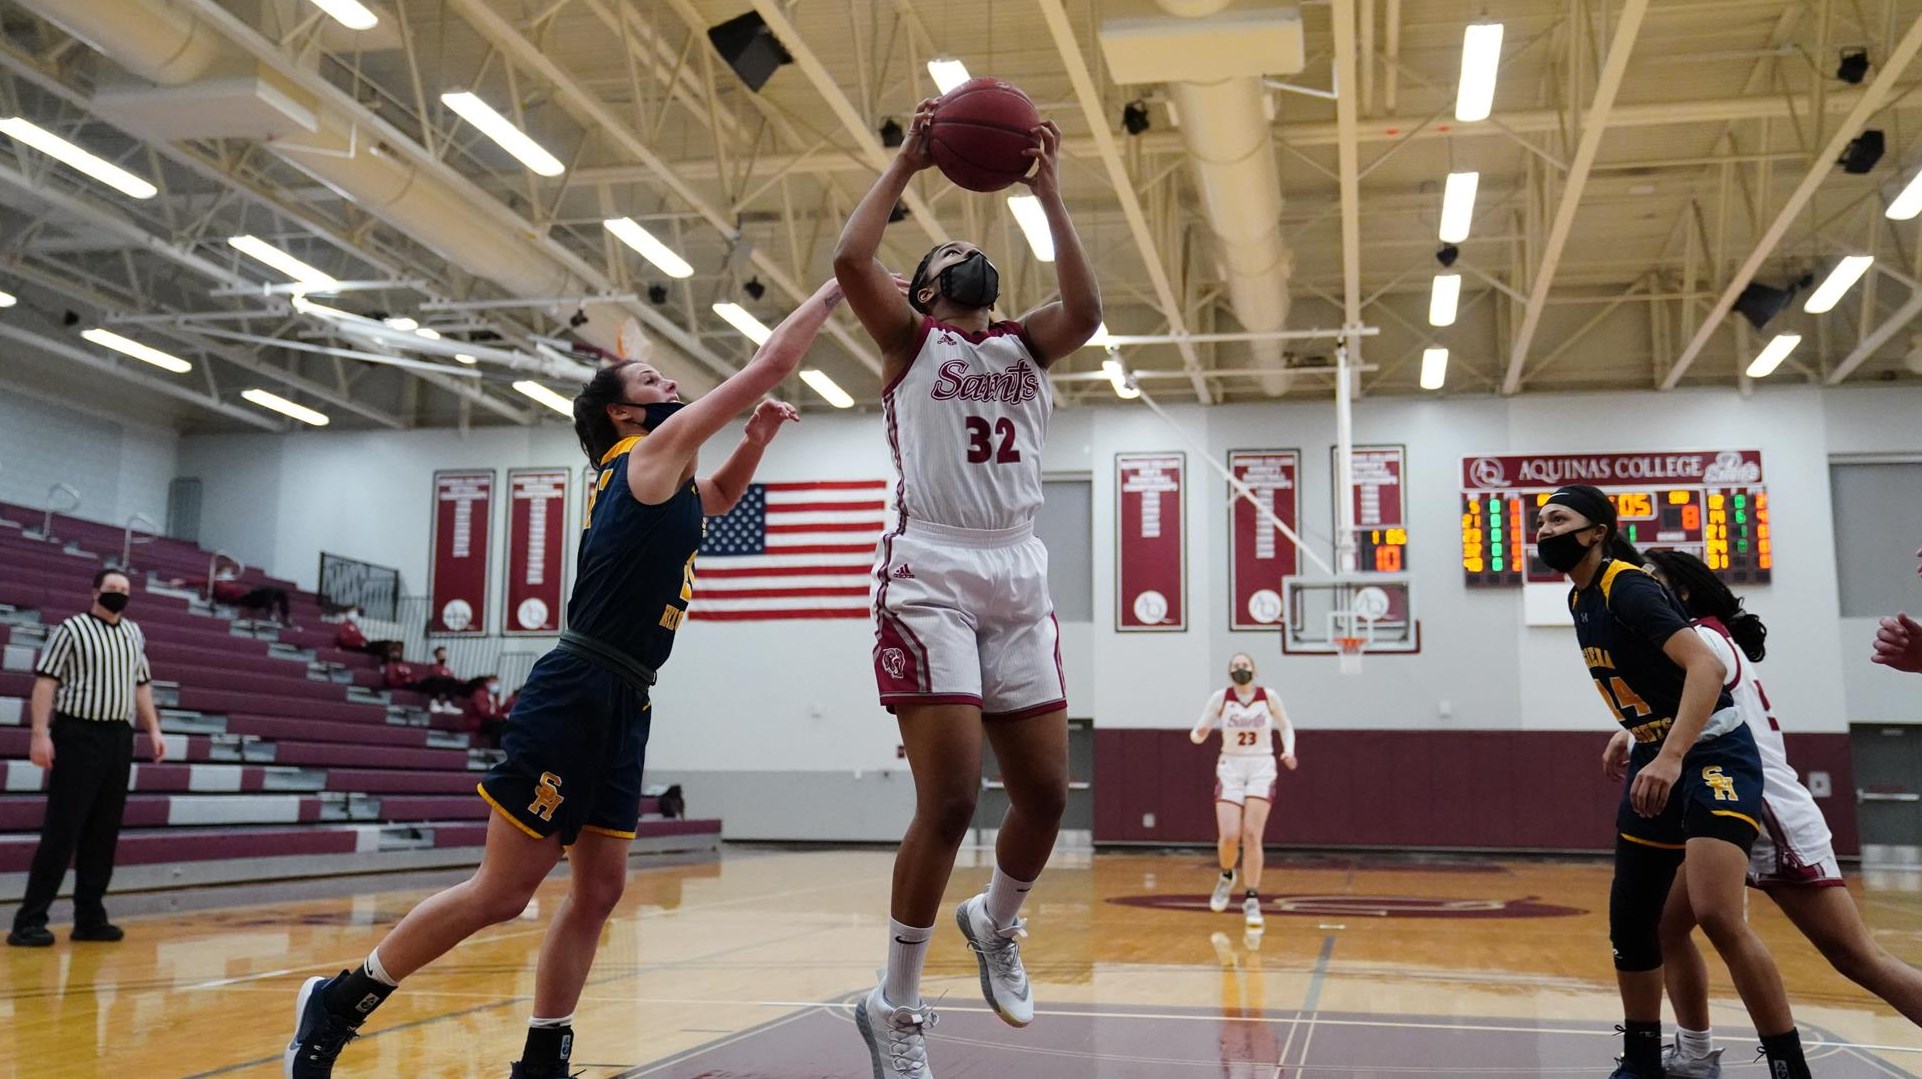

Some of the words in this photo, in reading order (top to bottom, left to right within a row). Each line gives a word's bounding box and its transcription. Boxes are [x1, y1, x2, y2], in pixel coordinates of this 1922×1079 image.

[965, 416, 1021, 464] 32
[1519, 459, 1609, 484] AQUINAS
[1614, 456, 1703, 478] COLLEGE
[1237, 731, 1258, 746] 23
